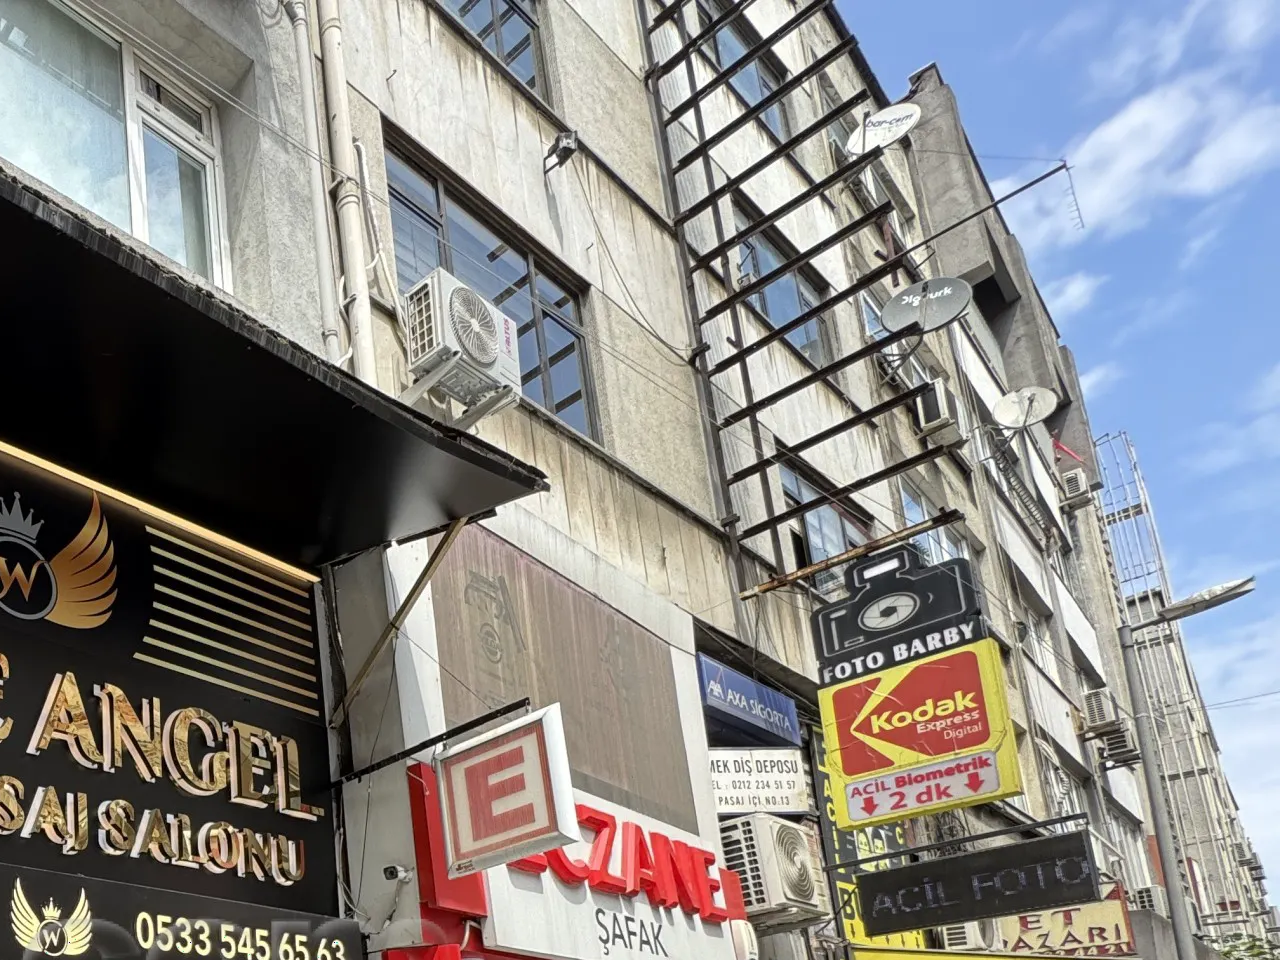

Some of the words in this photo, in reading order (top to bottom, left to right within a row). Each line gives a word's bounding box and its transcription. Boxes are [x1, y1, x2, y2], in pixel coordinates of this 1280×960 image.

[901, 285, 953, 306] Digurk
[823, 651, 885, 684] FOTO
[892, 620, 976, 662] BARBY
[726, 688, 750, 712] AXA
[750, 697, 792, 732] SİGORTA
[870, 690, 979, 735] Kodak
[916, 710, 981, 734] Express
[943, 721, 983, 741] Digital
[26, 671, 325, 822] ANGEL
[734, 756, 753, 776] DİŞ
[756, 759, 799, 774] DEPOSU
[464, 745, 537, 843] E
[732, 780, 752, 790] 0212
[755, 780, 771, 790] 234
[774, 780, 784, 790] 51
[786, 780, 796, 790] 57
[850, 778, 891, 799] ACİL
[894, 755, 993, 789] Biometrik
[888, 791, 909, 811] 2
[914, 783, 954, 805] dk
[718, 796, 745, 806] PASAJ
[97, 798, 305, 887] SALONU
[506, 803, 729, 922] ZANE
[971, 855, 1092, 900] FOTO
[135, 910, 212, 957] 0533
[595, 908, 668, 958] ŞAFAK
[1002, 923, 1122, 952] AZARI
[1018, 908, 1081, 930] ET
